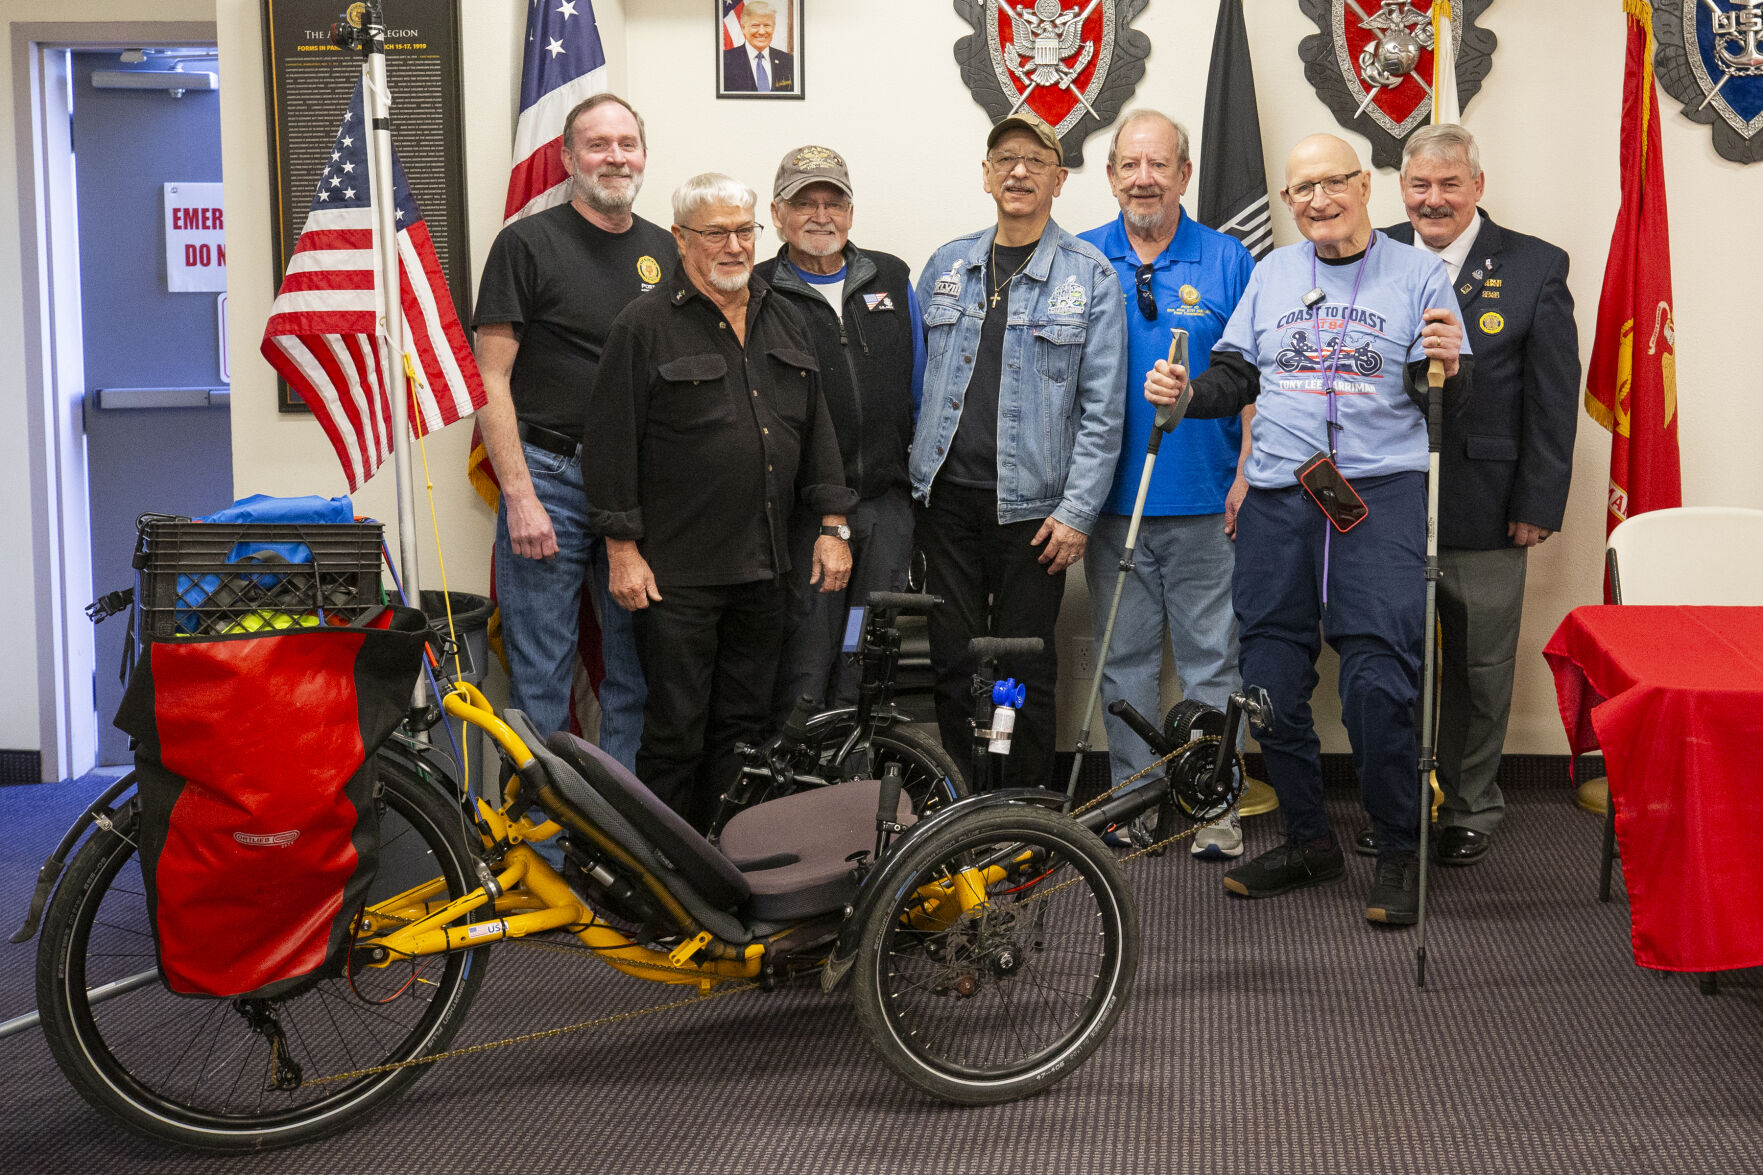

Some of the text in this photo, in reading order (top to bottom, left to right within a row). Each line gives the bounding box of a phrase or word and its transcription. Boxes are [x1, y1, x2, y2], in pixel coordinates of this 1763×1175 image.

[305, 30, 325, 39] THE
[172, 207, 224, 230] EMER
[185, 243, 211, 267] DO
[1277, 306, 1387, 333] COAST TO COAST
[1280, 379, 1377, 394] TONY LEE ARRIMAN
